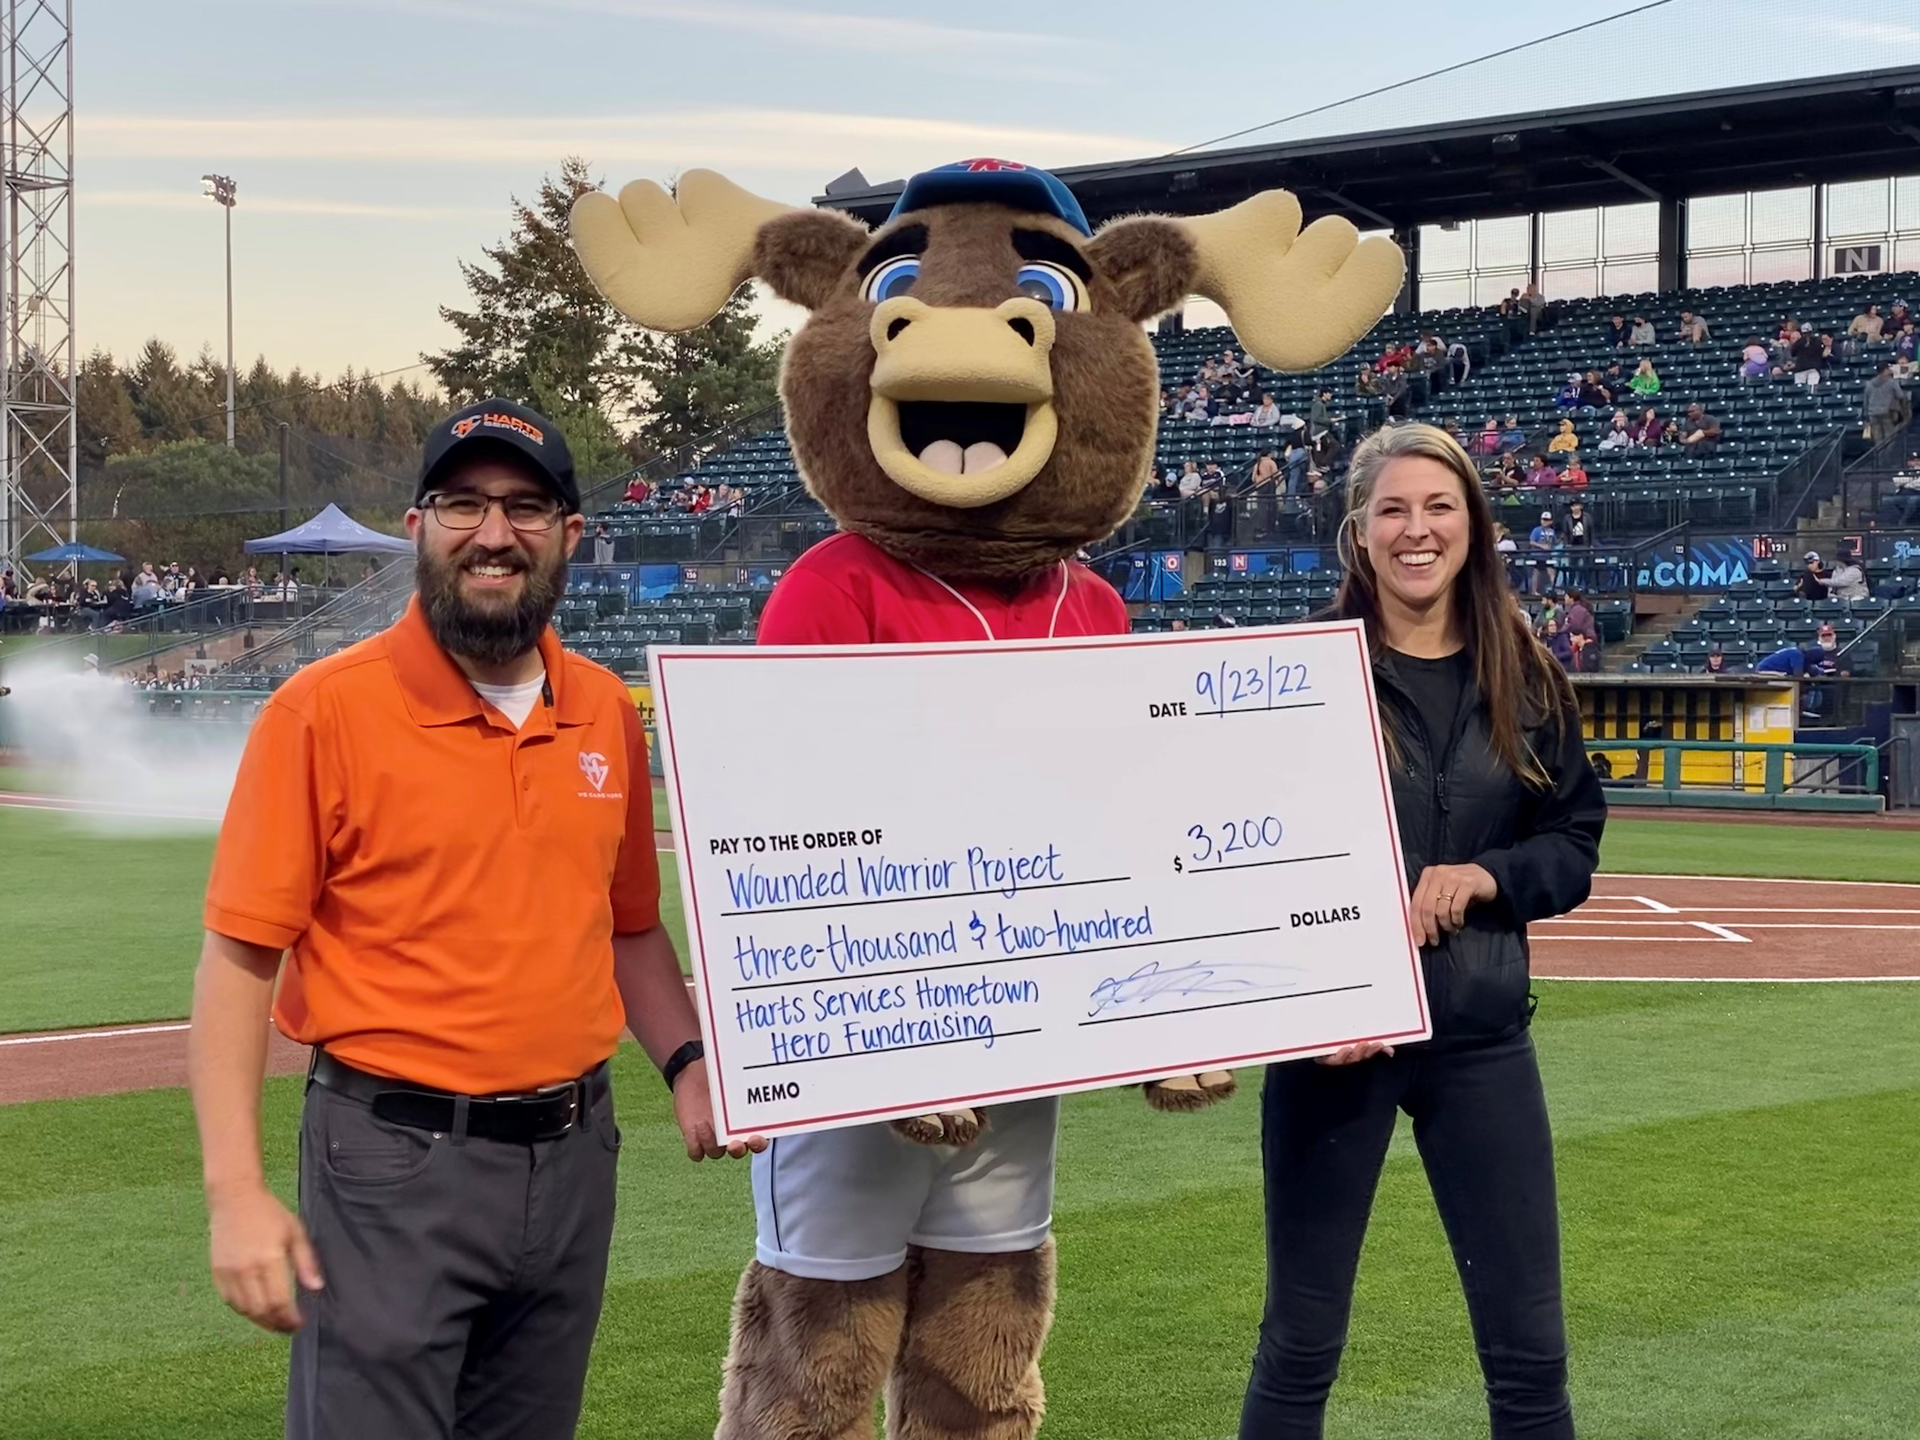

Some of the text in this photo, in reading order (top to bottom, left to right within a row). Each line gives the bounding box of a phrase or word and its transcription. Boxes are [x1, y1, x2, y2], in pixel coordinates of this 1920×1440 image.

[1844, 247, 1869, 272] N
[483, 413, 544, 438] HARTS
[1771, 543, 1786, 552] 121
[1196, 656, 1312, 718] 9/23/22
[1149, 701, 1188, 719] DATE
[709, 827, 884, 856] PAY TO THE ORDER OF
[1187, 816, 1283, 864] 3,200
[727, 844, 1065, 910] Wounded Warrior Project
[1173, 855, 1184, 874] $
[1290, 905, 1361, 928] DOLLARS
[734, 921, 958, 982] three-thousand
[995, 905, 1154, 954] two-hundred
[736, 975, 1039, 1033] Harts Services Hometown
[771, 1011, 995, 1065] Hero Fundraising
[746, 1080, 801, 1105] MEMO
